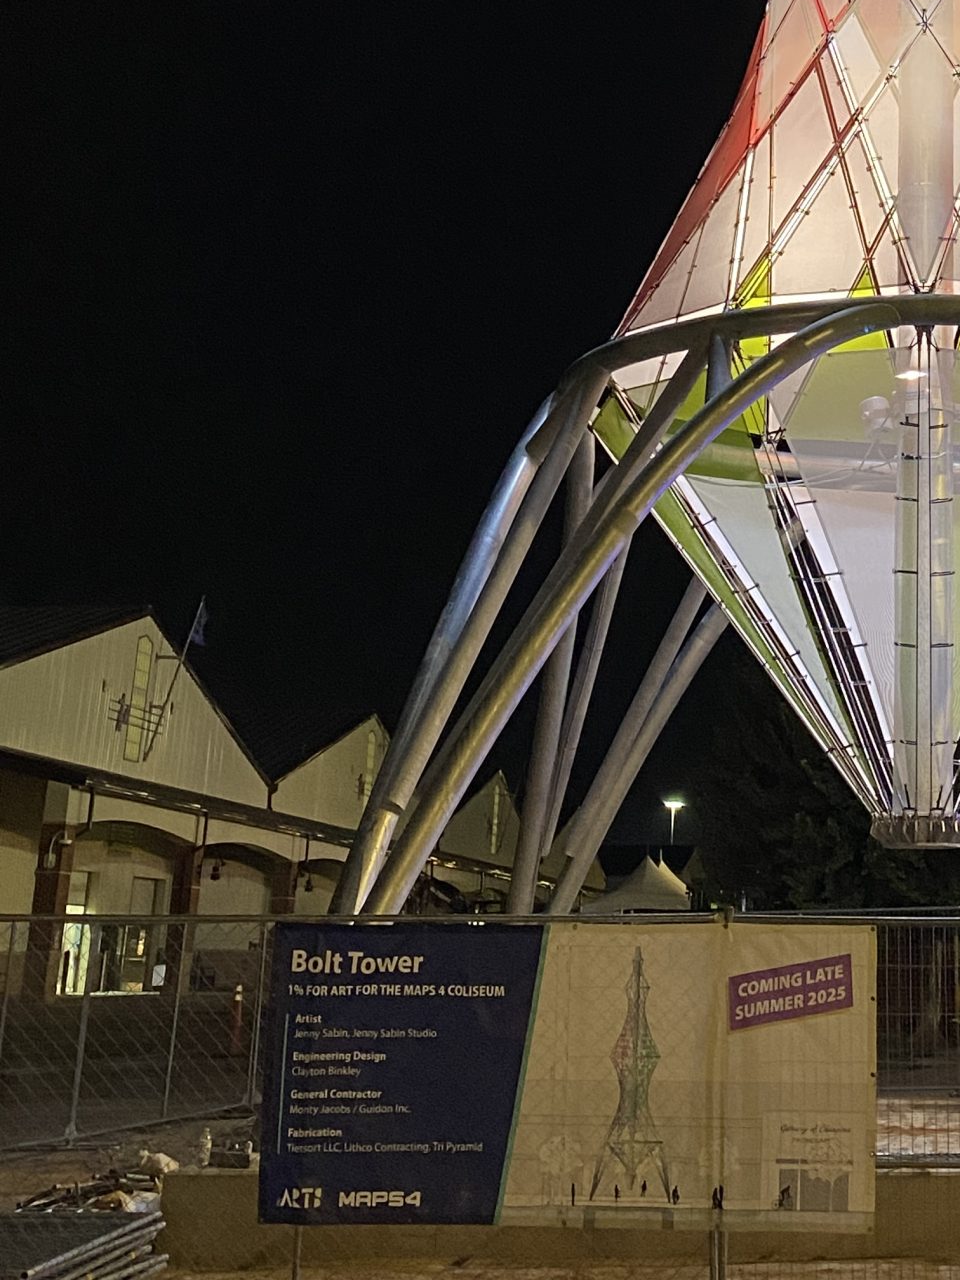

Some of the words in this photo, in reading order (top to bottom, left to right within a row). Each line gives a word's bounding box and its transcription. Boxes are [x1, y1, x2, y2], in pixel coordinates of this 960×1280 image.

[291, 949, 343, 974] Bolt
[348, 951, 424, 974] Tower
[737, 972, 803, 997] COMING
[806, 964, 844, 985] LATE
[288, 984, 304, 996] 1%
[306, 985, 328, 996] FOR
[330, 985, 353, 996] ART
[356, 985, 378, 995] FOR
[380, 984, 401, 995] THE
[403, 985, 436, 996] MAPS
[438, 985, 446, 996] 4
[447, 985, 506, 997] COLISEUM
[735, 994, 804, 1020] SUMMER
[807, 986, 846, 1006] 2025
[295, 1013, 322, 1024] Artist
[293, 1029, 320, 1040] Jenny
[352, 1029, 378, 1039] Jenny
[380, 1028, 406, 1038] Sabin
[408, 1028, 438, 1038] Studio
[292, 1051, 351, 1063] Engineering
[353, 1051, 387, 1063] Design
[291, 1066, 326, 1077] Clayton
[328, 1066, 361, 1077] Binkley
[290, 1089, 328, 1099] General
[329, 1089, 383, 1099] Contractor
[289, 1105, 319, 1116] Monty
[287, 1127, 343, 1138] Fabrication
[446, 1142, 484, 1154] Pyramid
[338, 1191, 421, 1207] MAPS4
